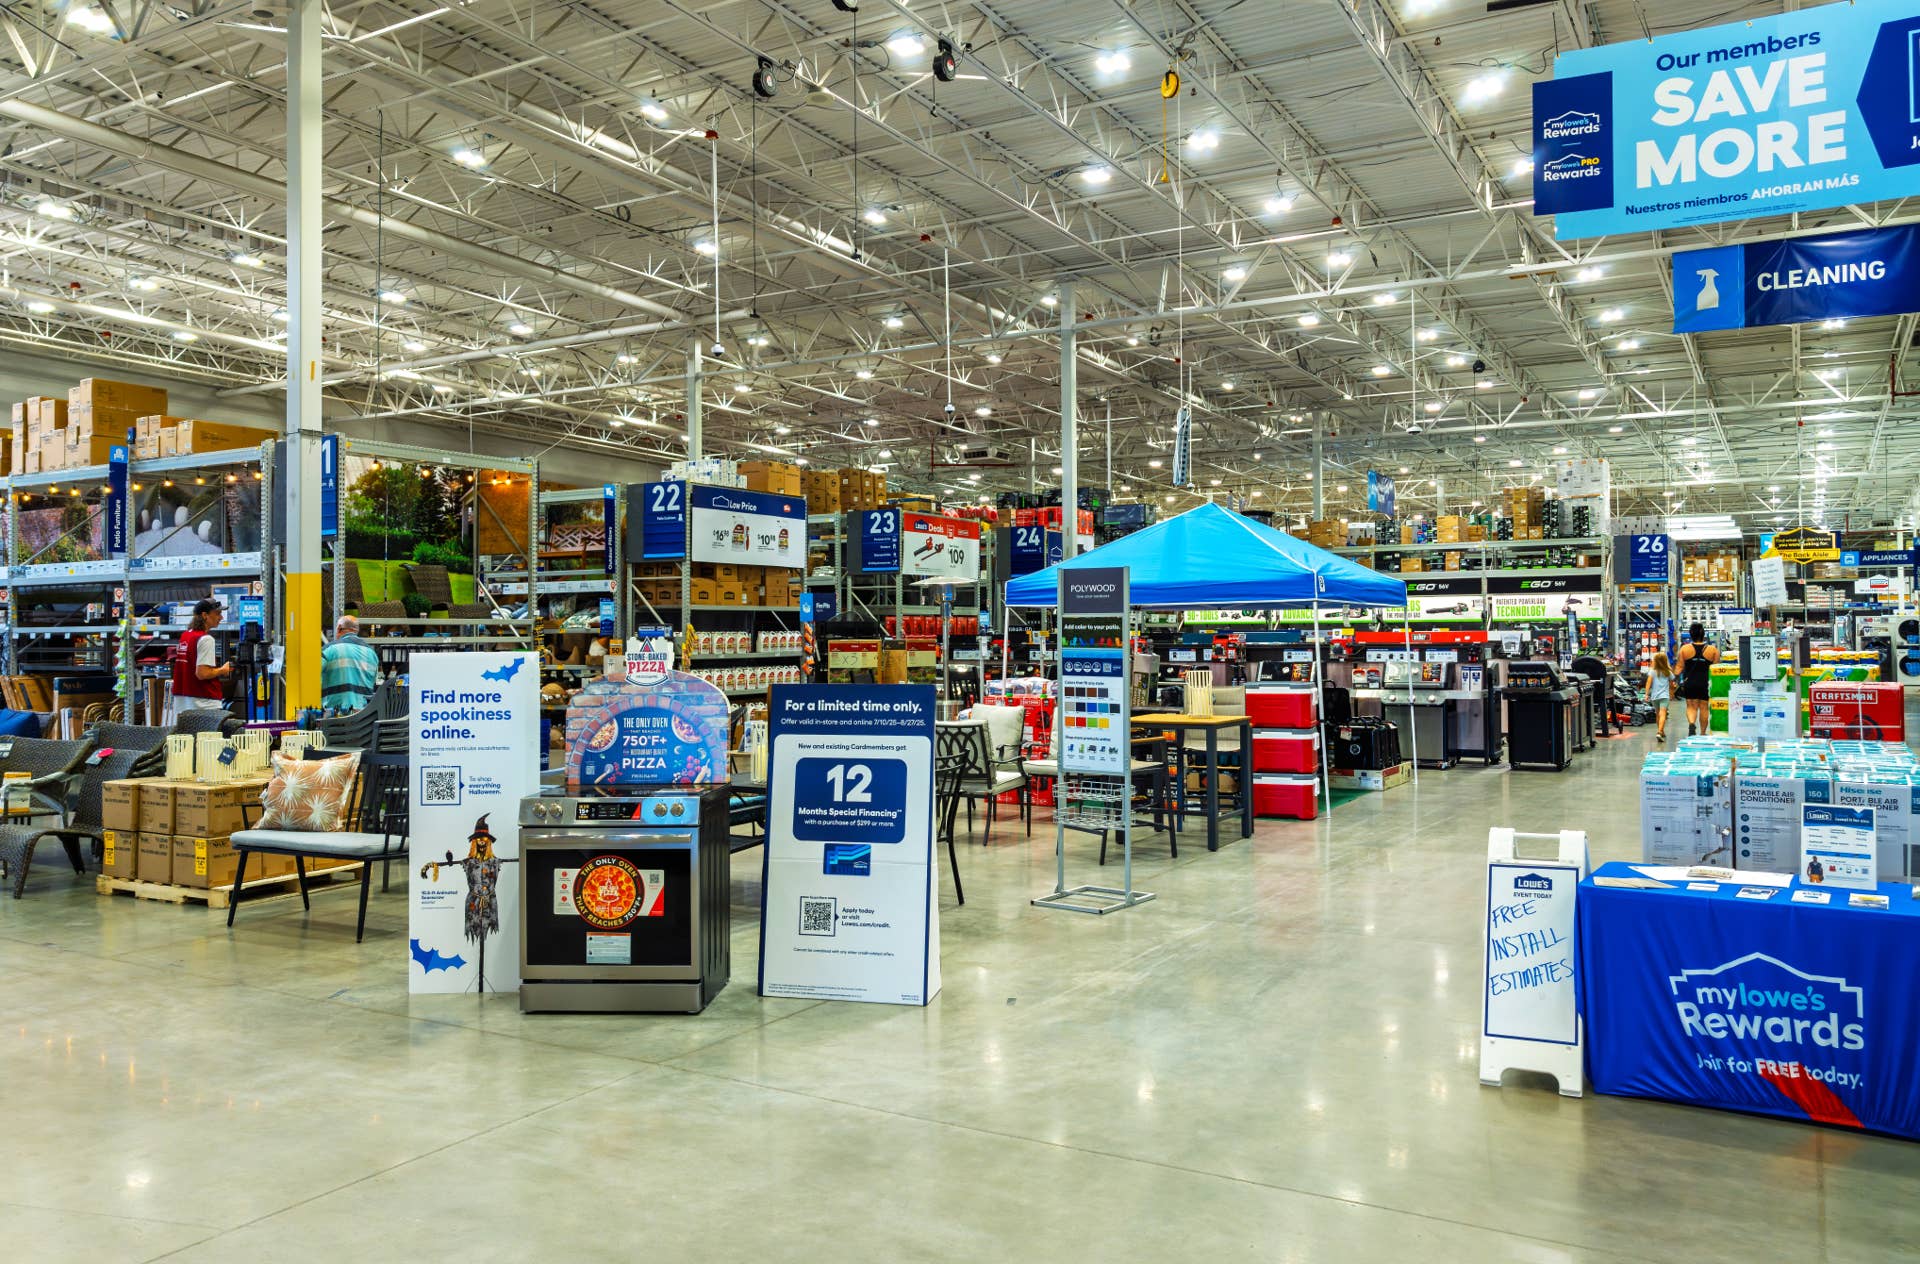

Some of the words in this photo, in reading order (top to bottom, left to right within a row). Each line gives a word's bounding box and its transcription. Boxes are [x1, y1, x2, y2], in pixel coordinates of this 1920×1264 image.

[1656, 52, 1700, 71] Our
[1707, 31, 1821, 65] members
[1651, 52, 1828, 127] SAVE
[1552, 117, 1589, 129] mylowe's
[1544, 123, 1600, 139] Rewards
[1636, 110, 1847, 190] MORE
[1581, 157, 1600, 166] PRO
[1544, 166, 1601, 181] Rewards
[1625, 201, 1681, 216] Nuestros
[1683, 191, 1748, 209] miembros
[1751, 179, 1824, 200] AHORRAN
[1825, 173, 1860, 191] MÁS
[1757, 261, 1886, 292] CLEANING
[652, 484, 681, 512] 22
[730, 502, 740, 510] Low
[741, 502, 757, 511] Price
[870, 512, 895, 534] 23
[928, 523, 944, 533] Deals
[1017, 527, 1040, 547] 24
[1638, 536, 1664, 553] 26
[1070, 584, 1115, 592] POLYWOOD
[1520, 581, 1551, 589] EGO
[1496, 606, 1546, 617] TECHNOLOGY
[628, 660, 667, 674] PIZZA
[421, 690, 455, 704] Find
[459, 693, 502, 704] more
[1816, 692, 1873, 700] CRAFTSMAN
[785, 700, 805, 712] For
[807, 702, 816, 712] a
[818, 700, 860, 712] limited
[862, 700, 890, 712] time
[893, 700, 922, 714] only.
[421, 707, 512, 723] spookiness
[780, 718, 797, 726] Offer
[799, 718, 814, 726] valid
[853, 718, 872, 726] online
[624, 717, 634, 728] THE
[636, 717, 652, 728] ONLY
[652, 717, 669, 728] OVEN
[421, 725, 476, 740] online.
[623, 735, 667, 746] 750°F+
[826, 743, 850, 752] existing
[622, 757, 667, 769] PIZZA
[826, 764, 873, 803] 12
[1740, 780, 1779, 789] Hisense
[1740, 789, 1780, 798] PORTABLE
[1740, 796, 1796, 804] CONDITIONER
[1808, 790, 1822, 798] 150
[798, 807, 828, 816] Months
[829, 808, 858, 817] Special
[581, 863, 594, 876] THE
[595, 858, 617, 866] ONLY
[618, 860, 638, 878] OVEN
[1517, 878, 1551, 890] LOWE'S
[576, 895, 589, 914] THAT
[587, 914, 624, 927] REACHES
[1492, 900, 1537, 928] FREE
[1492, 929, 1568, 960] INSTALL
[1490, 958, 1574, 996] ESTIMATES
[1697, 982, 1826, 1018] mylowe's
[1676, 1000, 1865, 1050] Rewards
[1698, 1053, 1725, 1071] Join
[1726, 1055, 1753, 1073] for
[1756, 1059, 1799, 1079] FREE
[1803, 1064, 1864, 1090] today.
